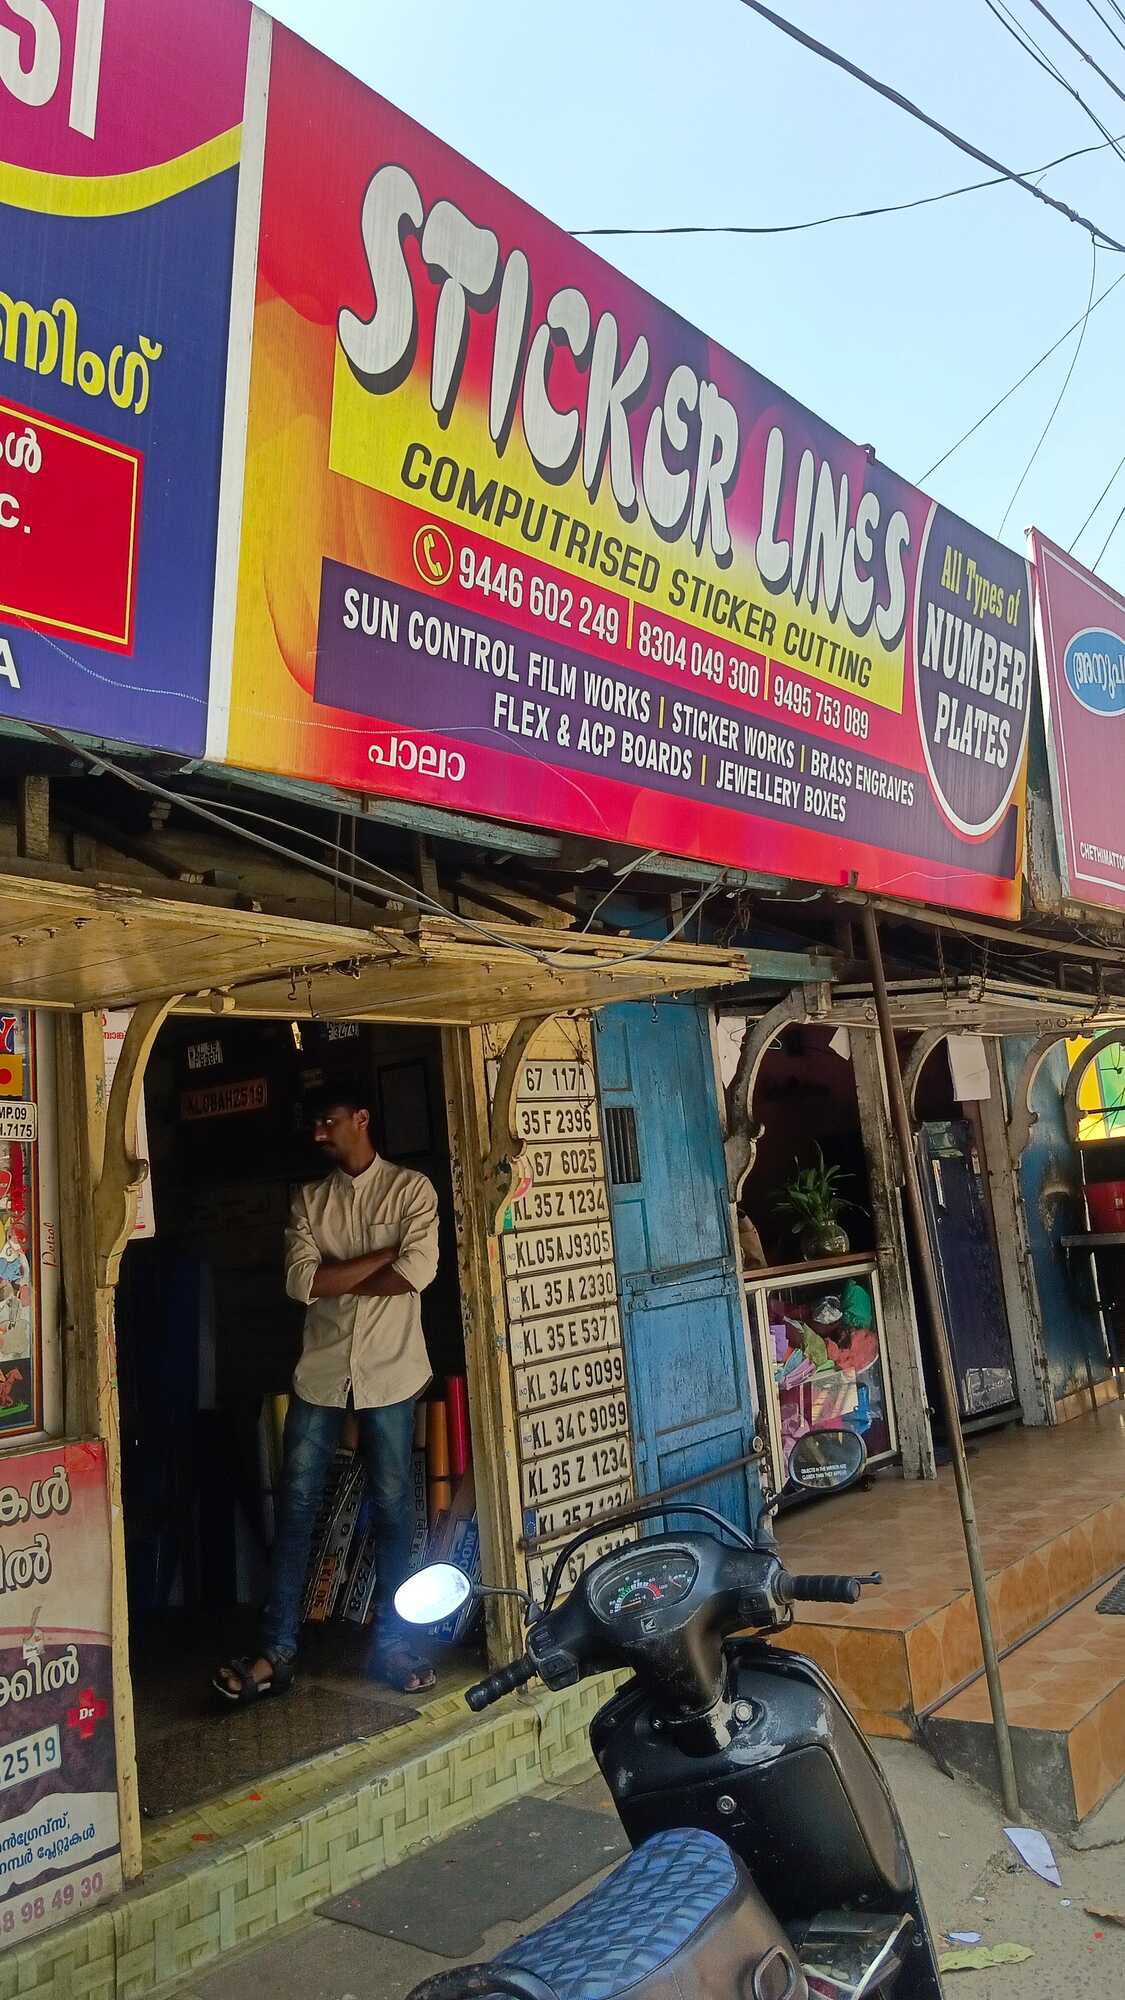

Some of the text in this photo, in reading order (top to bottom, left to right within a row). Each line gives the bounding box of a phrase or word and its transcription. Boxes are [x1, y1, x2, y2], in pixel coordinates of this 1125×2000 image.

[337, 163, 910, 650] STICKER LINES
[401, 443, 872, 688] COMPUTRISED STICKER CUTTING
[941, 545, 1020, 627] All Types of
[459, 547, 619, 645] 9446 602 249
[343, 588, 650, 724] SUN CONTROL FILM WORKS
[638, 621, 759, 697] 8304 049 300
[922, 602, 1027, 710] NUMBER
[774, 675, 869, 739] 9495 753 089
[934, 691, 1011, 769] PLATES
[368, 736, 465, 782] പാലാ
[494, 692, 692, 780] FLEX & ACP BOARDS
[672, 702, 794, 768] STICKER WORKS
[716, 760, 847, 822] JEWELLERY BOXES
[811, 749, 914, 807] BRASS ENGRAVES
[525, 1067, 587, 1091] 67 1171
[0, 1123, 32, 1138] .7175
[521, 1110, 592, 1135] 35 F 2396
[534, 1149, 597, 1177] 67 6025
[535, 1193, 553, 1218] 35
[556, 1191, 565, 1216] Z
[568, 1188, 605, 1216] 1234
[515, 1230, 610, 1268] KL05AJ9305
[520, 1284, 541, 1312] KL
[544, 1280, 563, 1307] 35
[567, 1277, 576, 1303] A
[578, 1272, 613, 1301] 2330
[523, 1315, 616, 1357] KL 35 E 5371
[527, 1374, 546, 1403] KL
[549, 1367, 569, 1396] 34
[572, 1365, 581, 1391] C
[584, 1357, 623, 1387] 9099
[531, 1420, 552, 1449] KL
[555, 1413, 575, 1444] 34
[577, 1410, 587, 1437] C
[590, 1401, 627, 1433] 9099
[528, 1443, 628, 1498] KL 35 Z 1234
[79, 1708, 94, 1720] Dr
[3, 1736, 56, 1781] 2519
[52, 1883, 75, 1910] 49
[80, 1871, 103, 1898] 30
